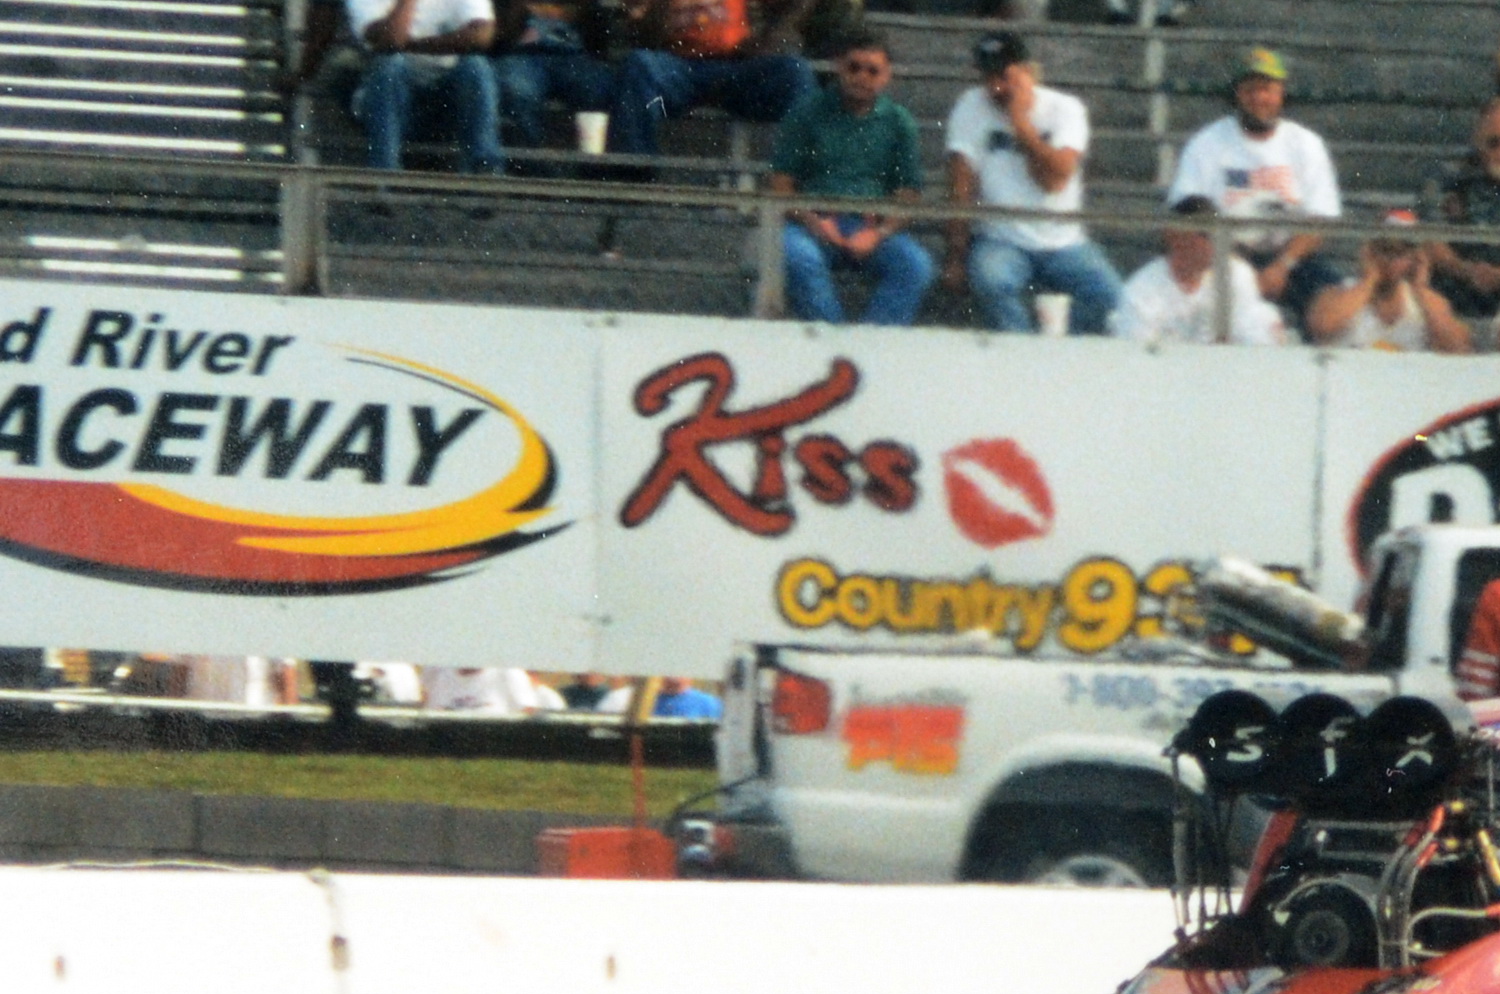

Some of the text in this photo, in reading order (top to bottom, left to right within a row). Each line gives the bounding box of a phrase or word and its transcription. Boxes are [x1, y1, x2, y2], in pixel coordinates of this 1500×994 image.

[70, 309, 295, 376] River
[0, 384, 488, 488] ACEWAY
[620, 352, 921, 537] Kiss
[1427, 417, 1493, 462] WE
[776, 556, 1058, 653] Country
